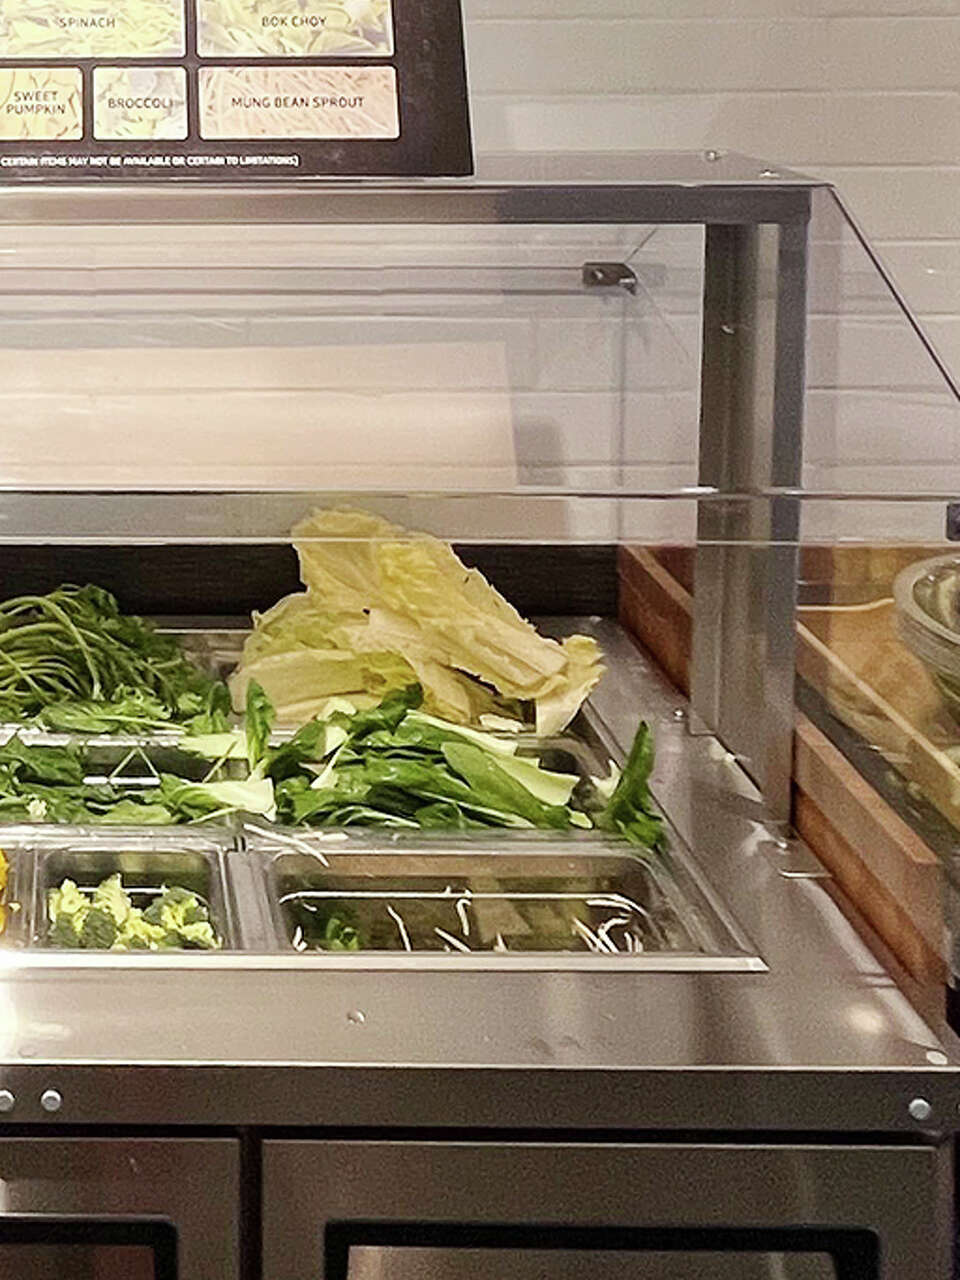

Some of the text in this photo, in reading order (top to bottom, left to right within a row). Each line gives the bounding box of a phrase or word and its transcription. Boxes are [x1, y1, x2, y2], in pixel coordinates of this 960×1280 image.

[58, 16, 116, 29] SPINACH
[261, 15, 328, 28] BOK CHOY
[13, 90, 59, 103] SWEET
[230, 96, 366, 109] MUNG BEAN SPROUT
[5, 102, 67, 116] PUMPKIN
[107, 97, 174, 110] BROCCOLI
